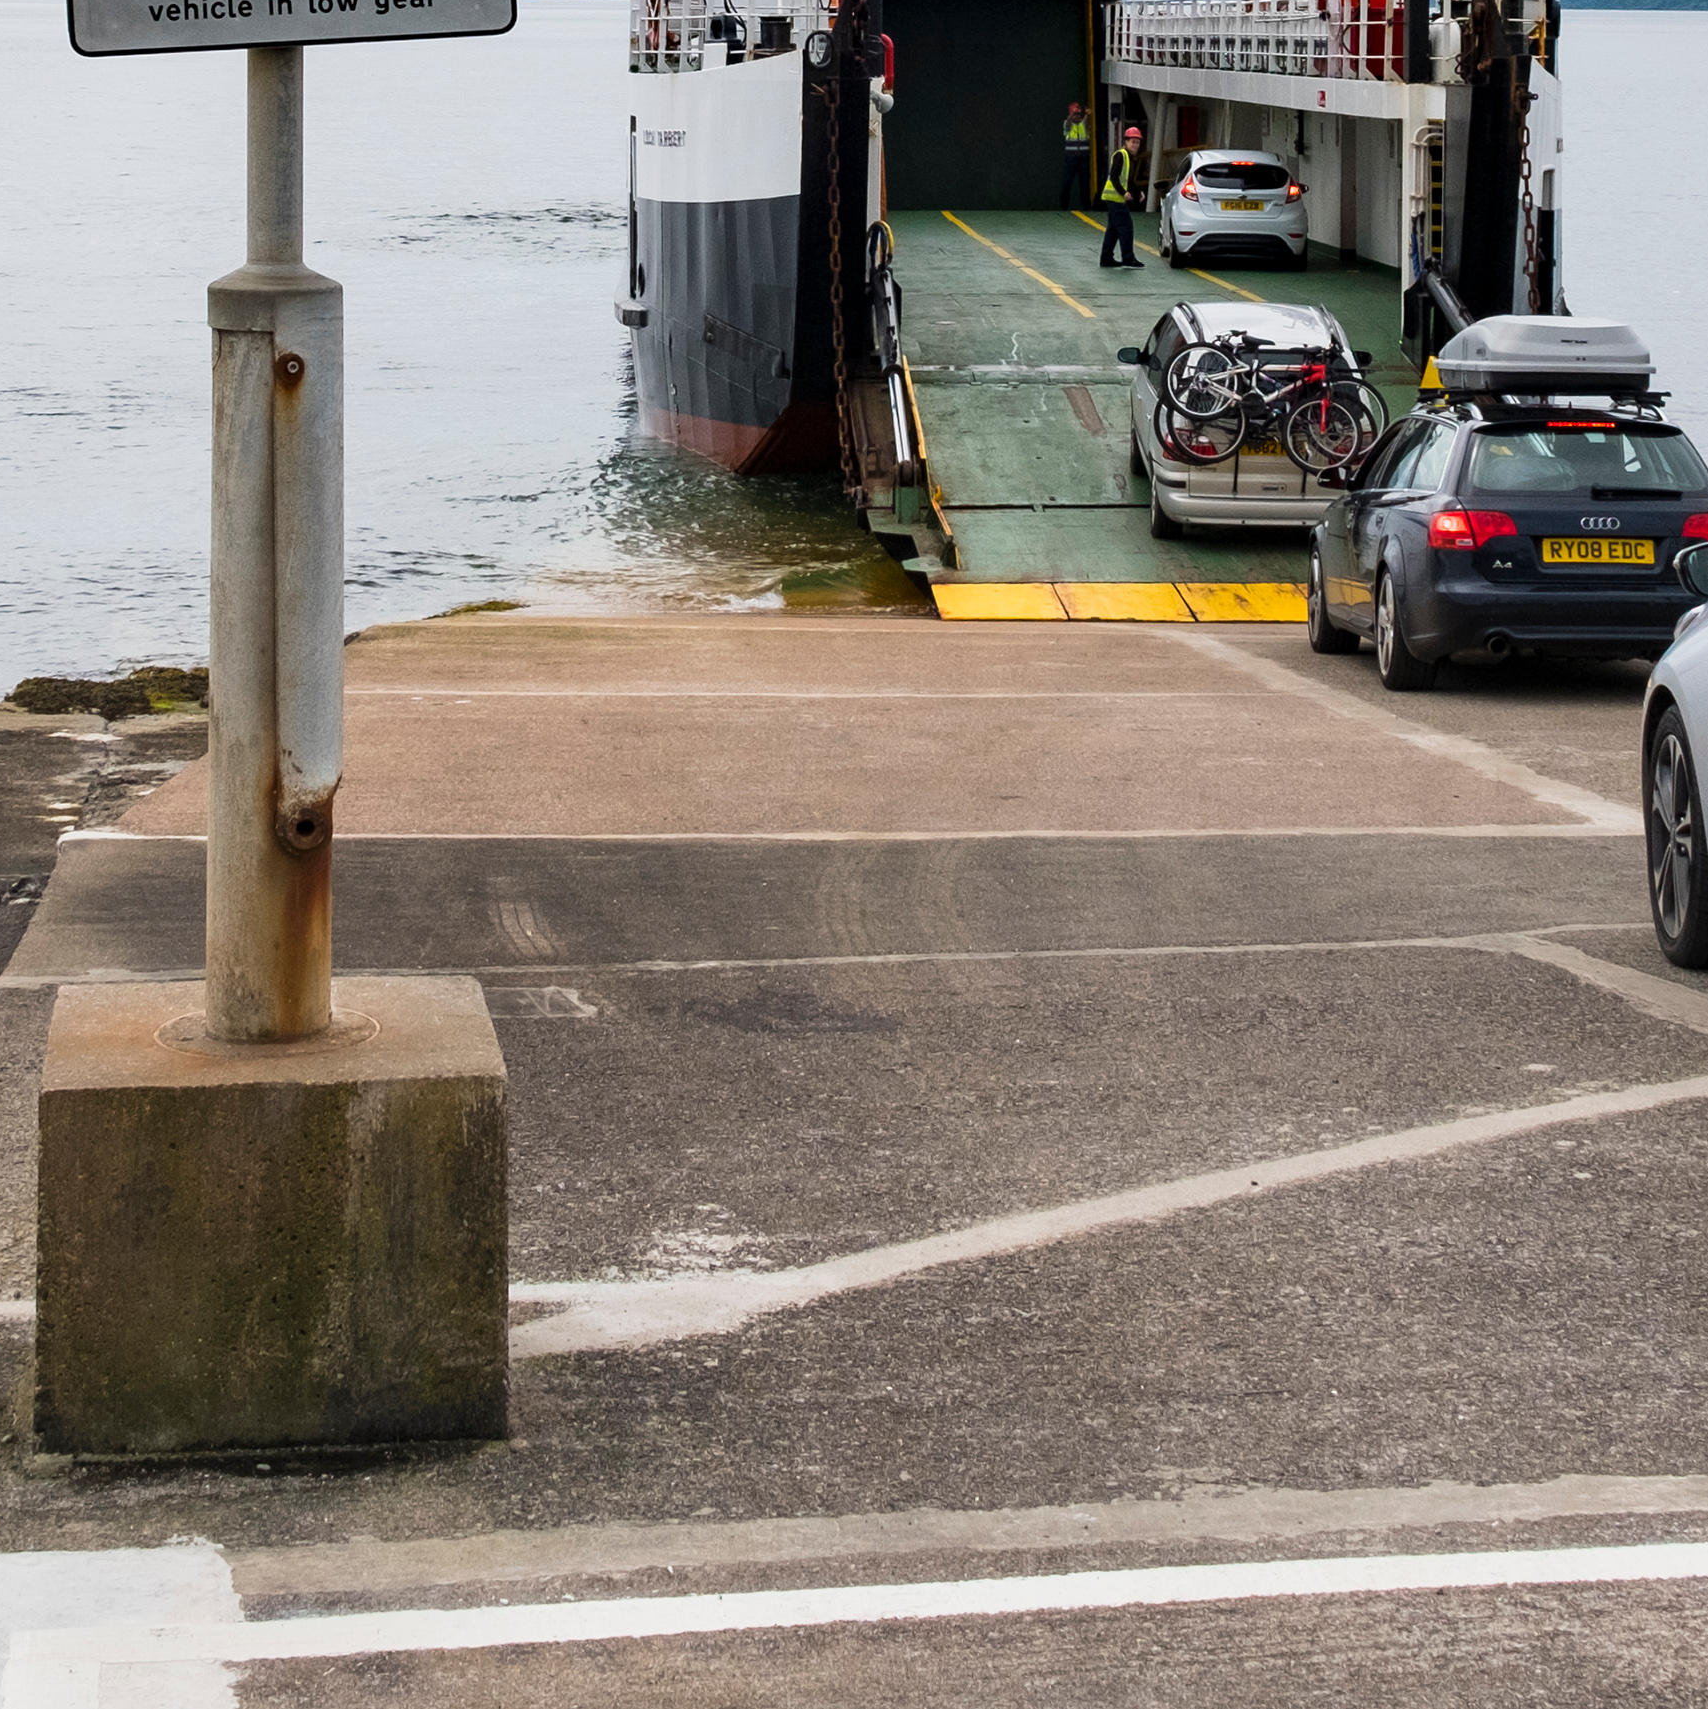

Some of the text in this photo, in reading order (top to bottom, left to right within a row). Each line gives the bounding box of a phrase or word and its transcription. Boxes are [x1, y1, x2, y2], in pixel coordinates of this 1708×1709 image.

[1550, 541, 1645, 559] RY08 EDC
[1492, 559, 1513, 569] A4
